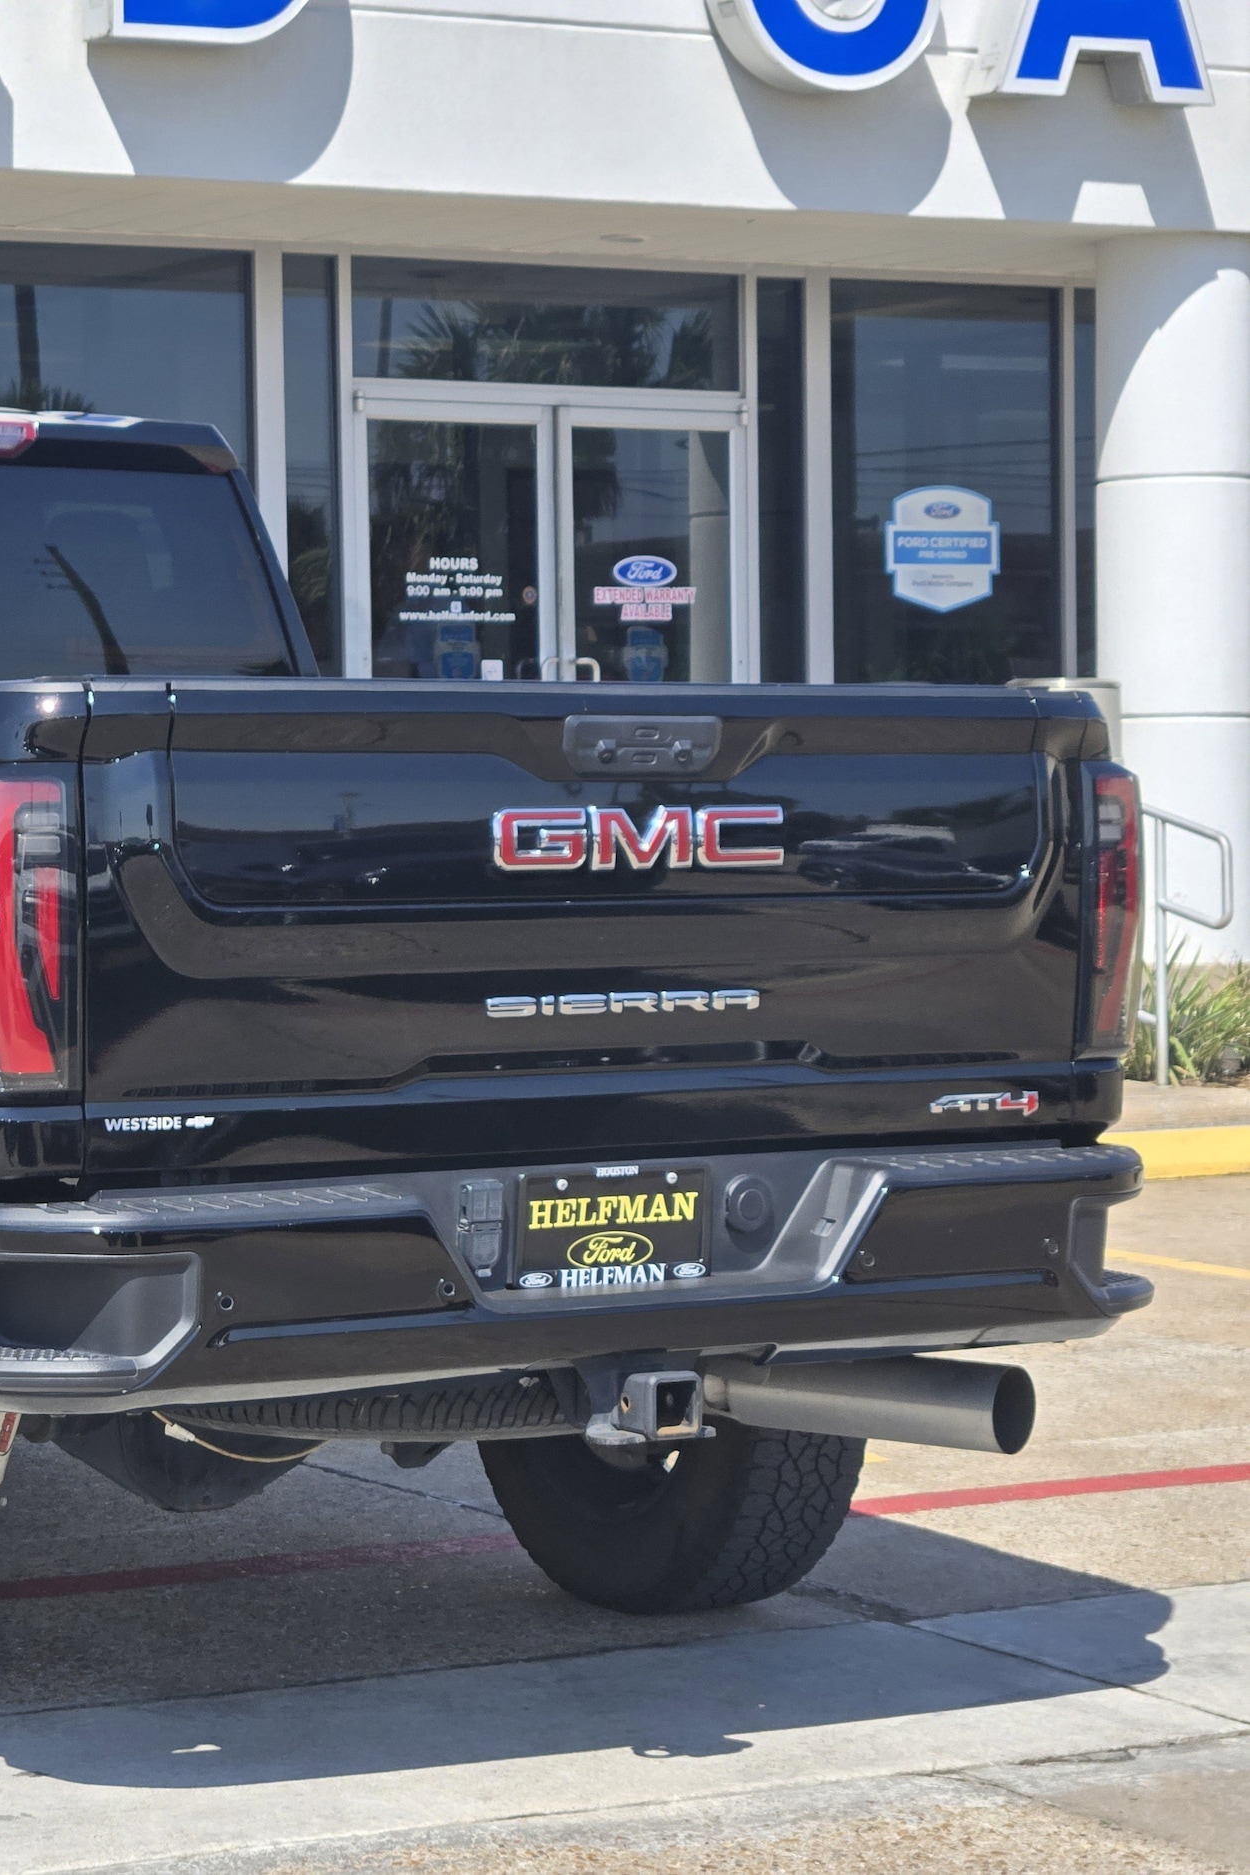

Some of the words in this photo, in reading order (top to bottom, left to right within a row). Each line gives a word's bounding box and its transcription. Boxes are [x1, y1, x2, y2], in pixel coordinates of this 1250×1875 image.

[897, 536, 929, 548] FORD
[930, 537, 988, 549] CERTIFIED
[430, 557, 478, 571] HOURS
[627, 561, 664, 580] Ford
[406, 572, 448, 586] Monday
[455, 573, 503, 587] Saturday
[406, 585, 430, 597] 9:00
[459, 586, 483, 597] 9:00
[485, 588, 504, 599] pm
[593, 587, 644, 604] EXTENDED
[644, 587, 697, 604] WARRANTY
[620, 604, 672, 621] AVAILABLE
[494, 805, 785, 871] GMC
[486, 989, 761, 1018] SIERRA
[930, 1091, 1039, 1117] AT4
[104, 1116, 182, 1132] WESTSIDE
[595, 1165, 639, 1177] HOUSTON
[528, 1191, 699, 1230] HELFMAN
[582, 1236, 637, 1265] Ford
[560, 1263, 666, 1288] HELFMAN
